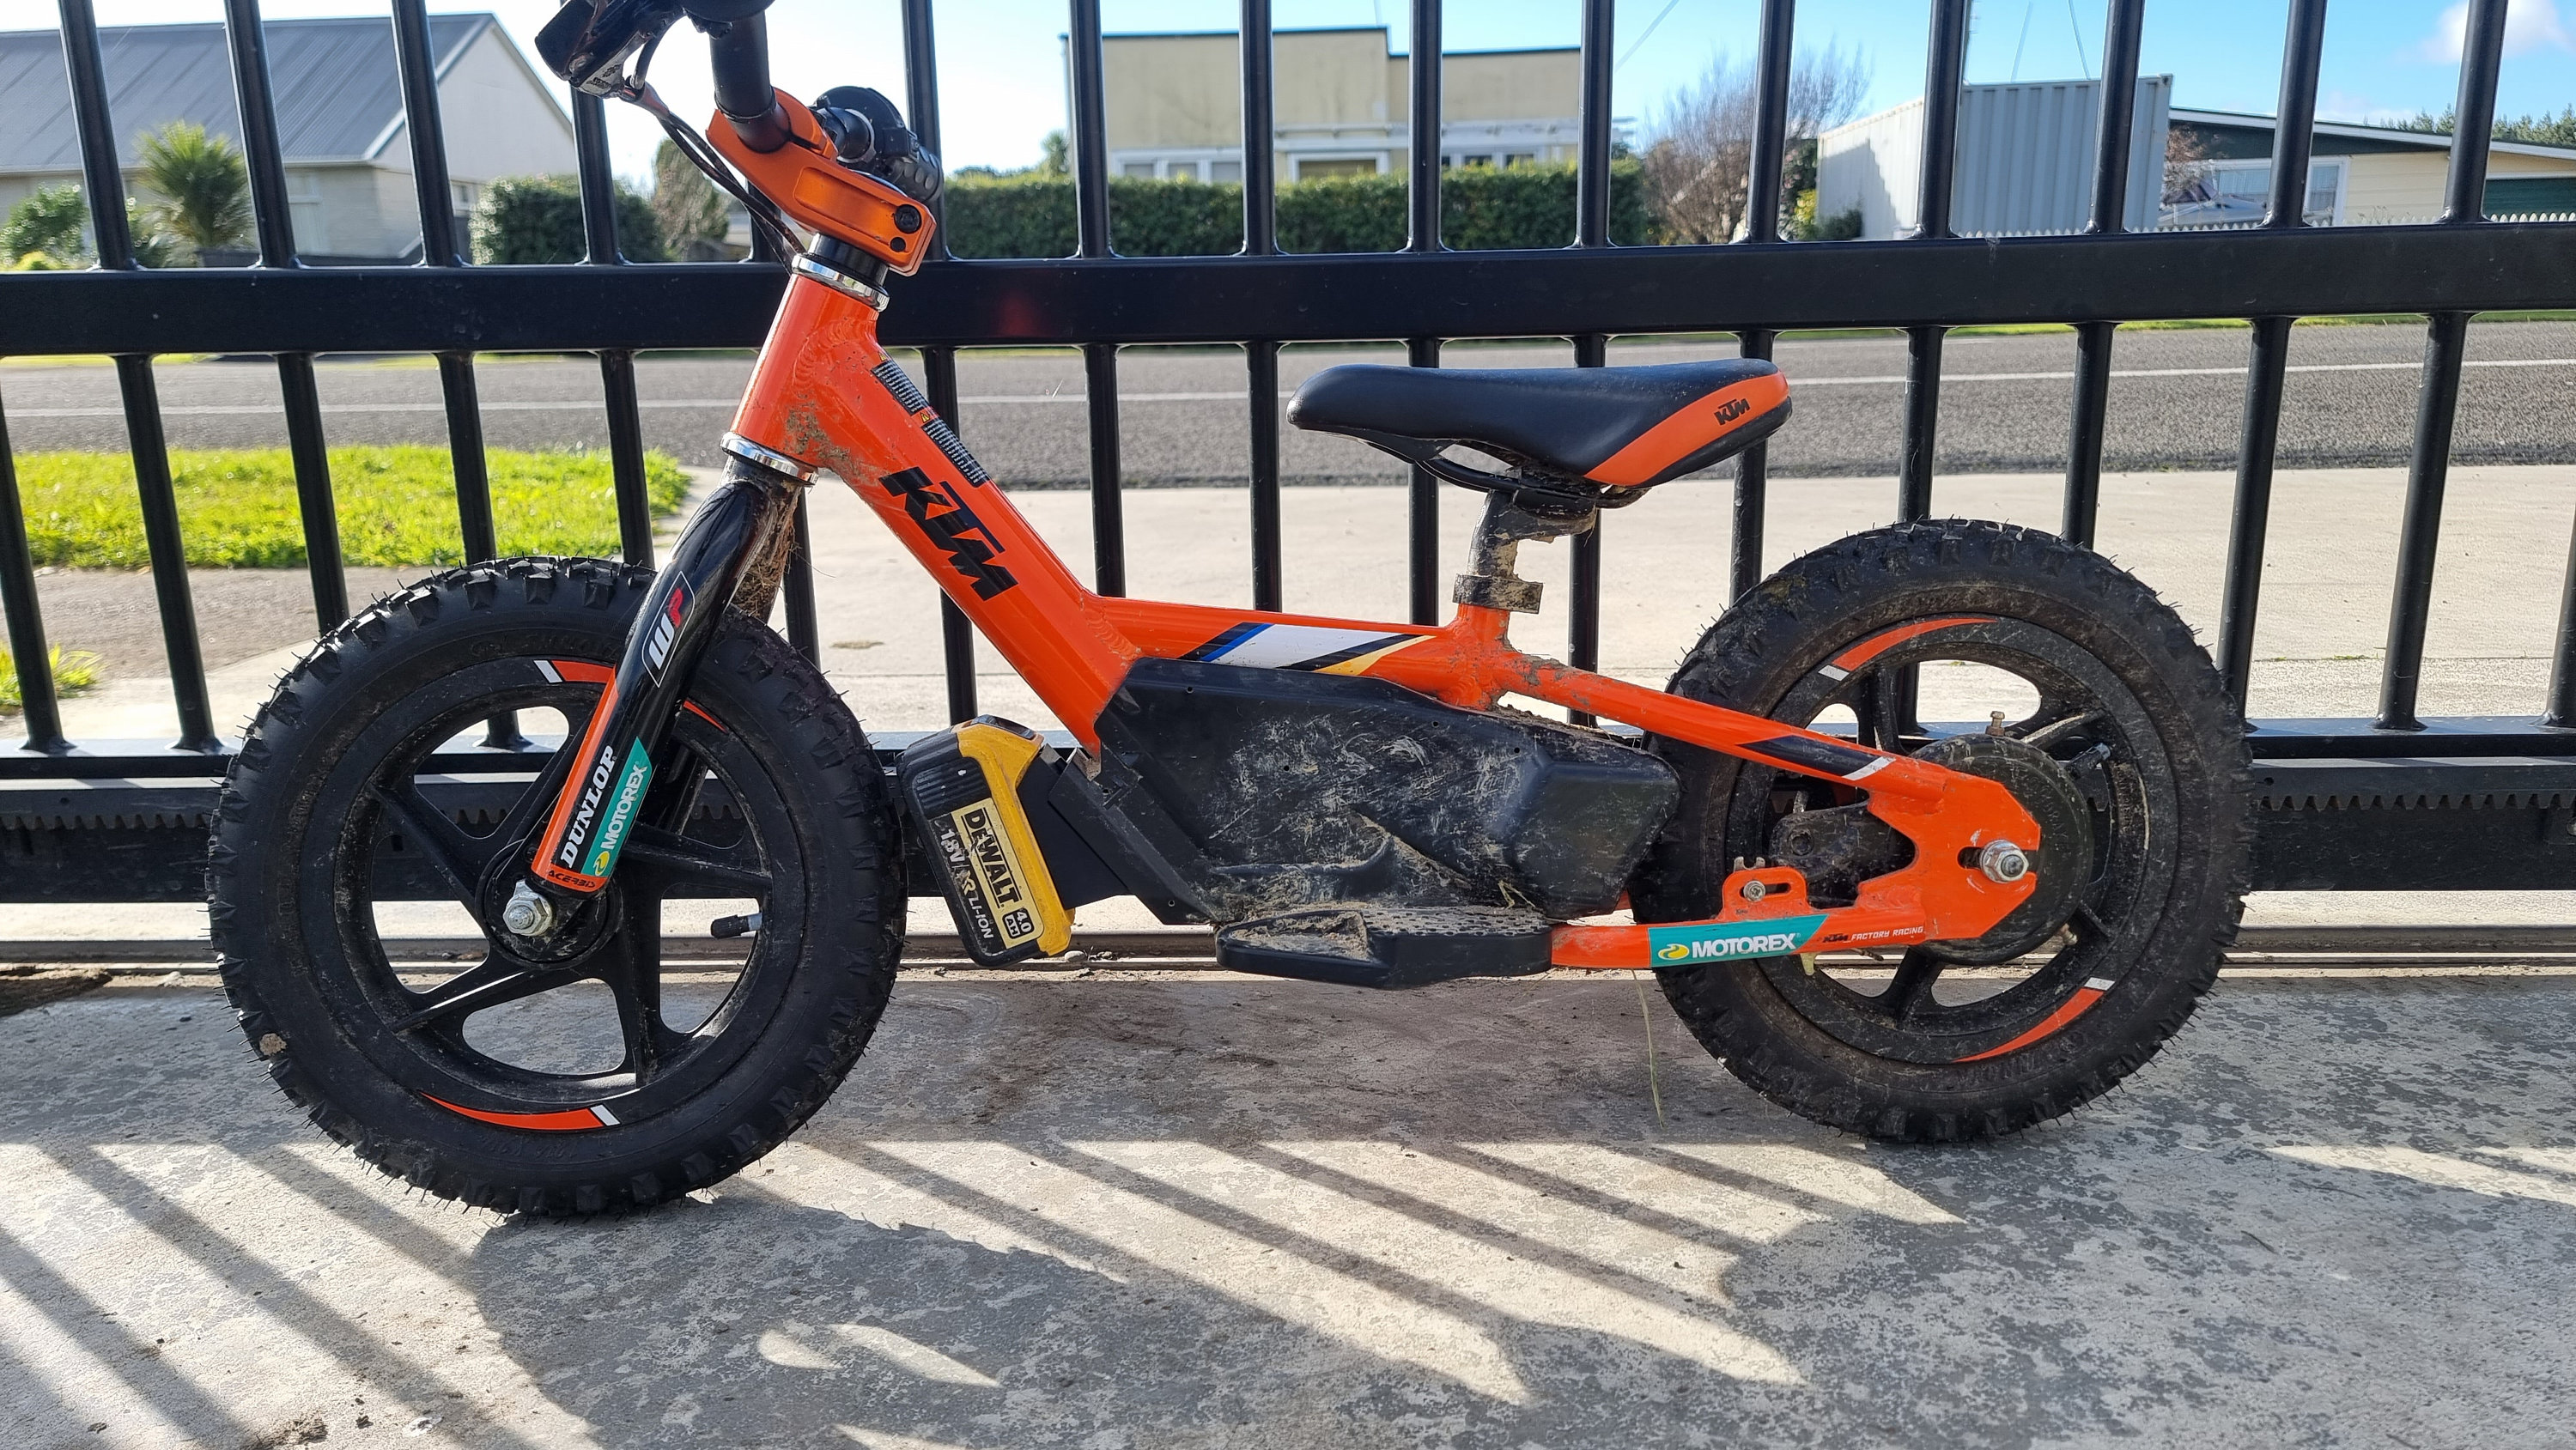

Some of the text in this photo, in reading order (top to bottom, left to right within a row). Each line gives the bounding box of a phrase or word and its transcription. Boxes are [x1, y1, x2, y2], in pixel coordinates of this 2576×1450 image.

[1714, 398, 1751, 426] KTM
[878, 466, 1019, 602] KTM
[648, 587, 683, 670] WP
[561, 745, 615, 869] DUNLOP
[600, 764, 648, 850] MOTOREX
[963, 808, 1021, 906] DEWALT
[1005, 914, 1021, 938] AH
[1016, 910, 1033, 933] 4.0
[1692, 932, 1796, 959] MOTOREX
[1850, 930, 1890, 941] FACTORY
[1893, 925, 1924, 937] RACING
